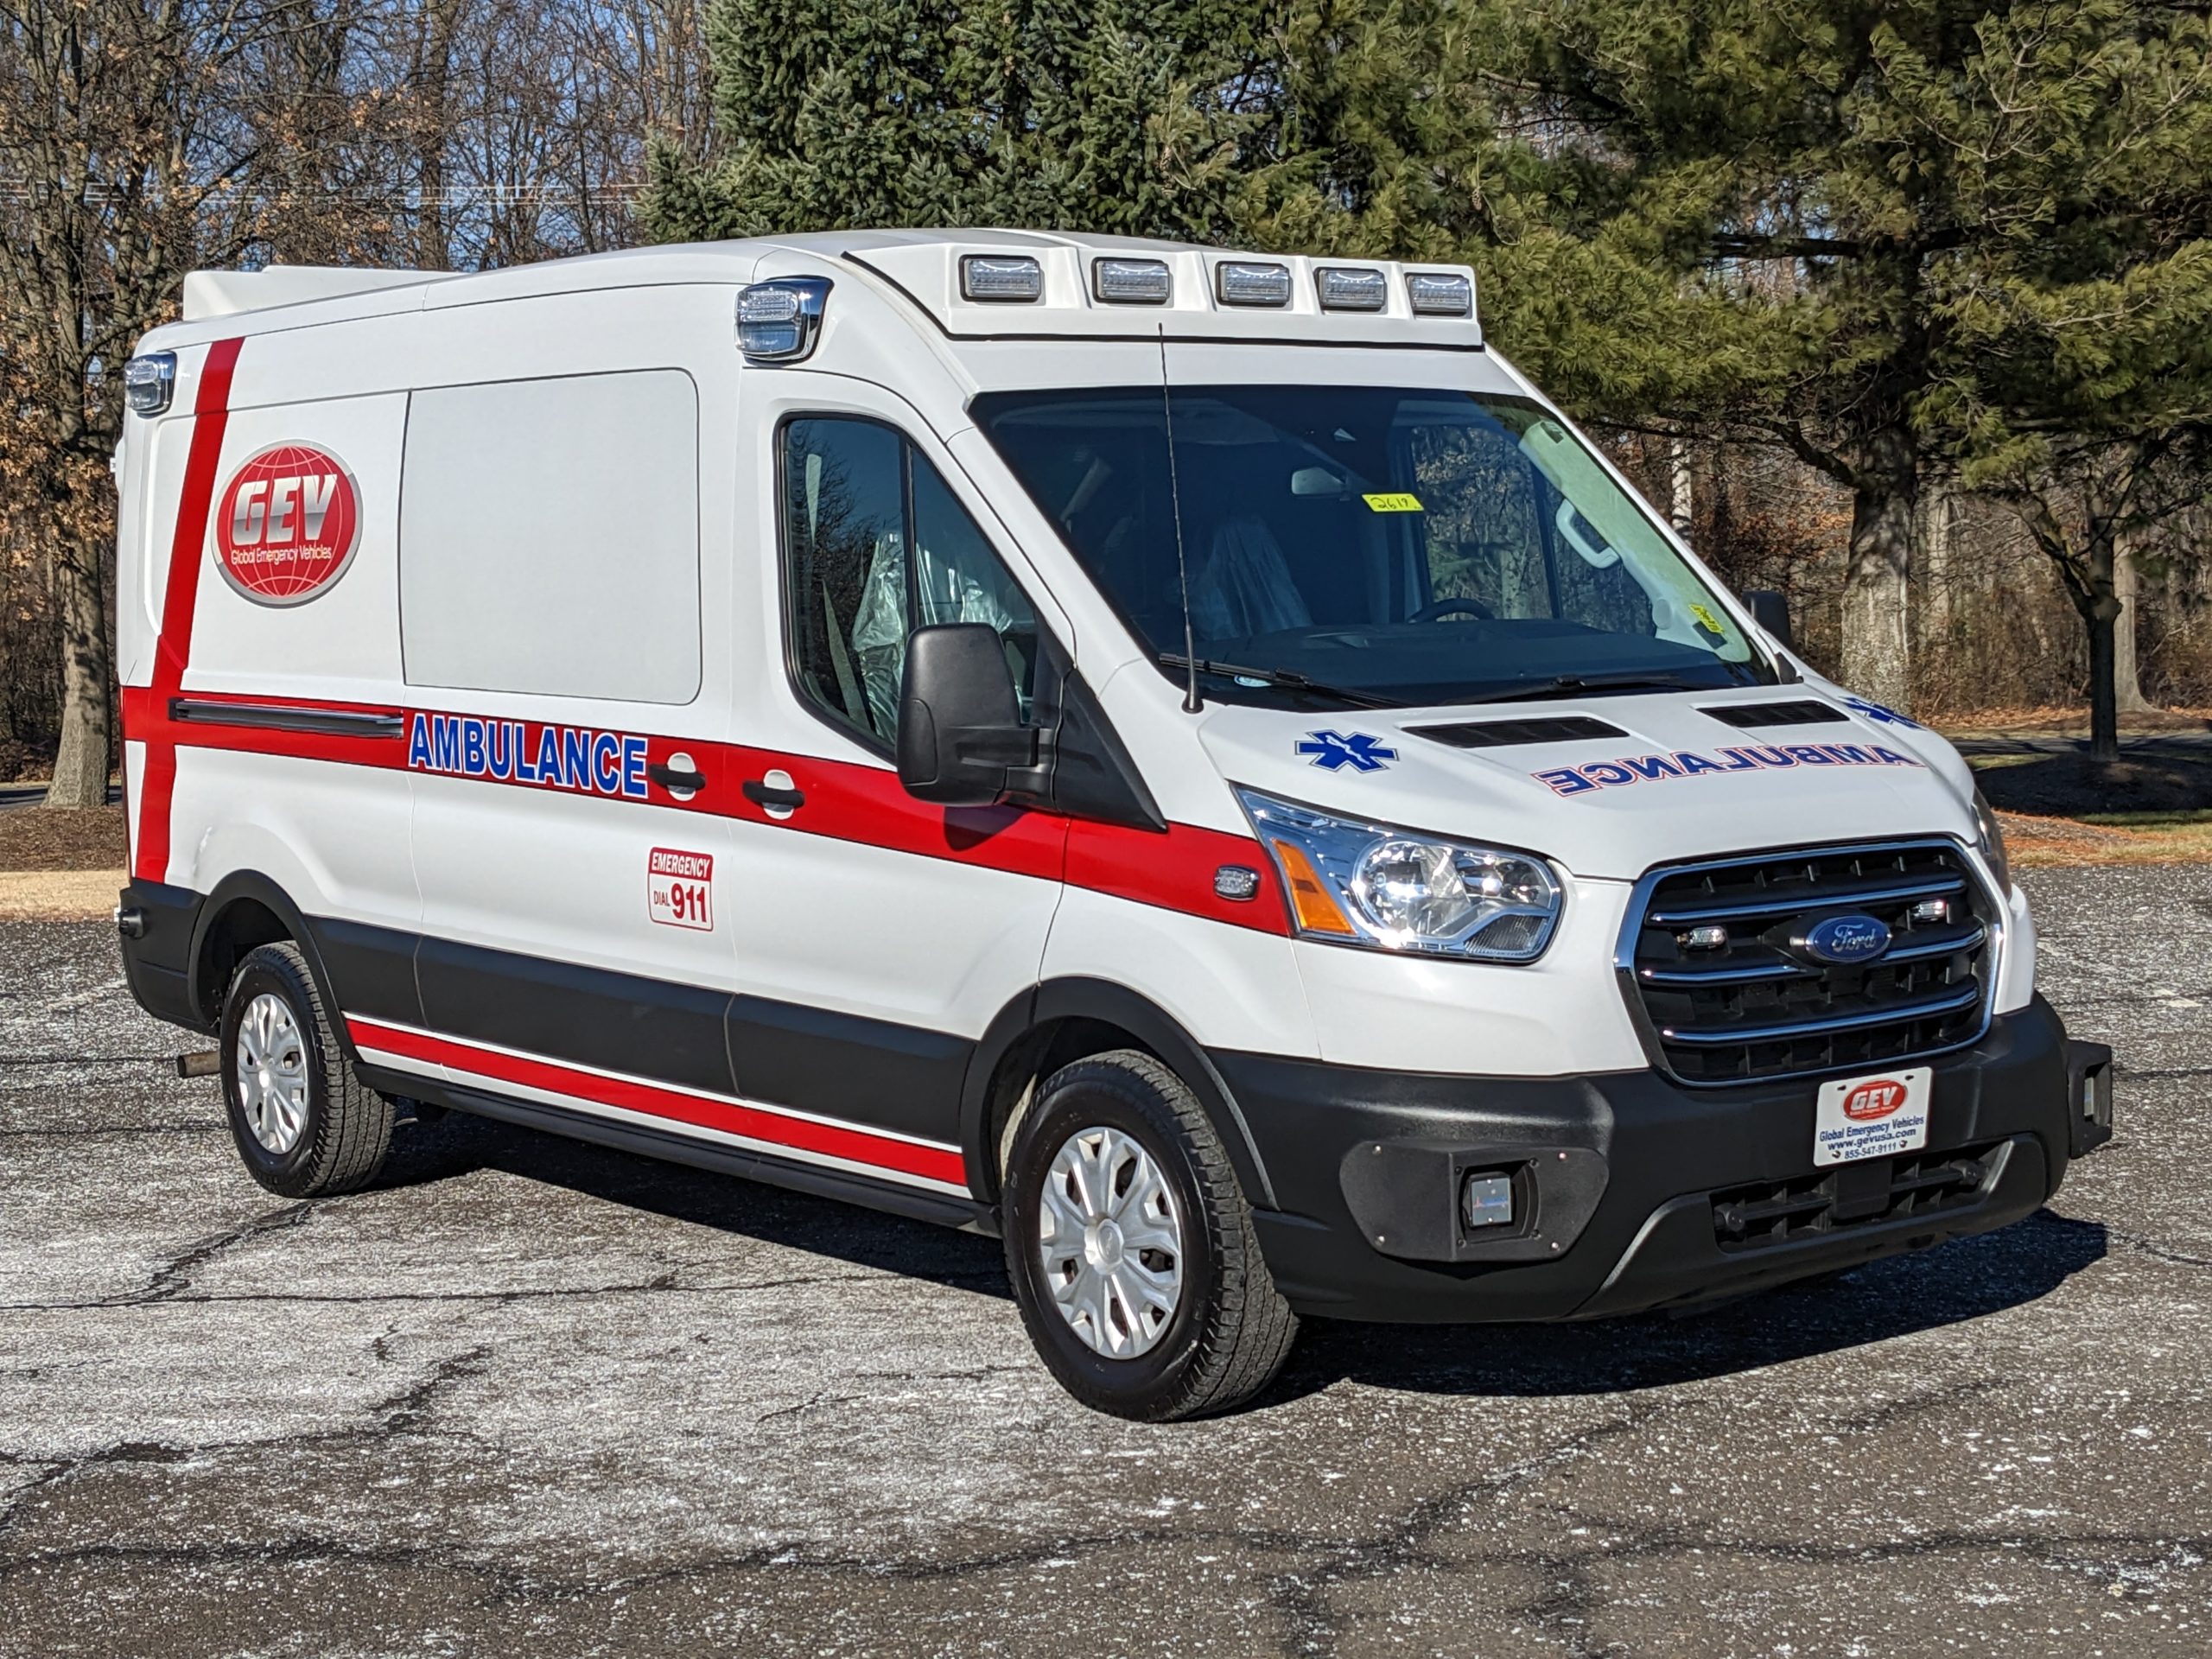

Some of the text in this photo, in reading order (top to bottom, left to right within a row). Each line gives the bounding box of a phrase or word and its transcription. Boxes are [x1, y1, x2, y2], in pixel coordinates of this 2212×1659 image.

[232, 474, 337, 545] GEV
[231, 544, 332, 565] Global Emergency Vehicles
[408, 713, 648, 798] AMBULANCE
[652, 852, 710, 878] EMERGENCY
[653, 882, 707, 923] DIAL 911
[1832, 924, 1877, 952] Ford
[1850, 1086, 1898, 1111] GEV
[1819, 1116, 1924, 1141] Global Emergency Vehicles
[1827, 1128, 1916, 1150] www.gevusa.com
[1844, 1142, 1897, 1159] 855-547-9111
